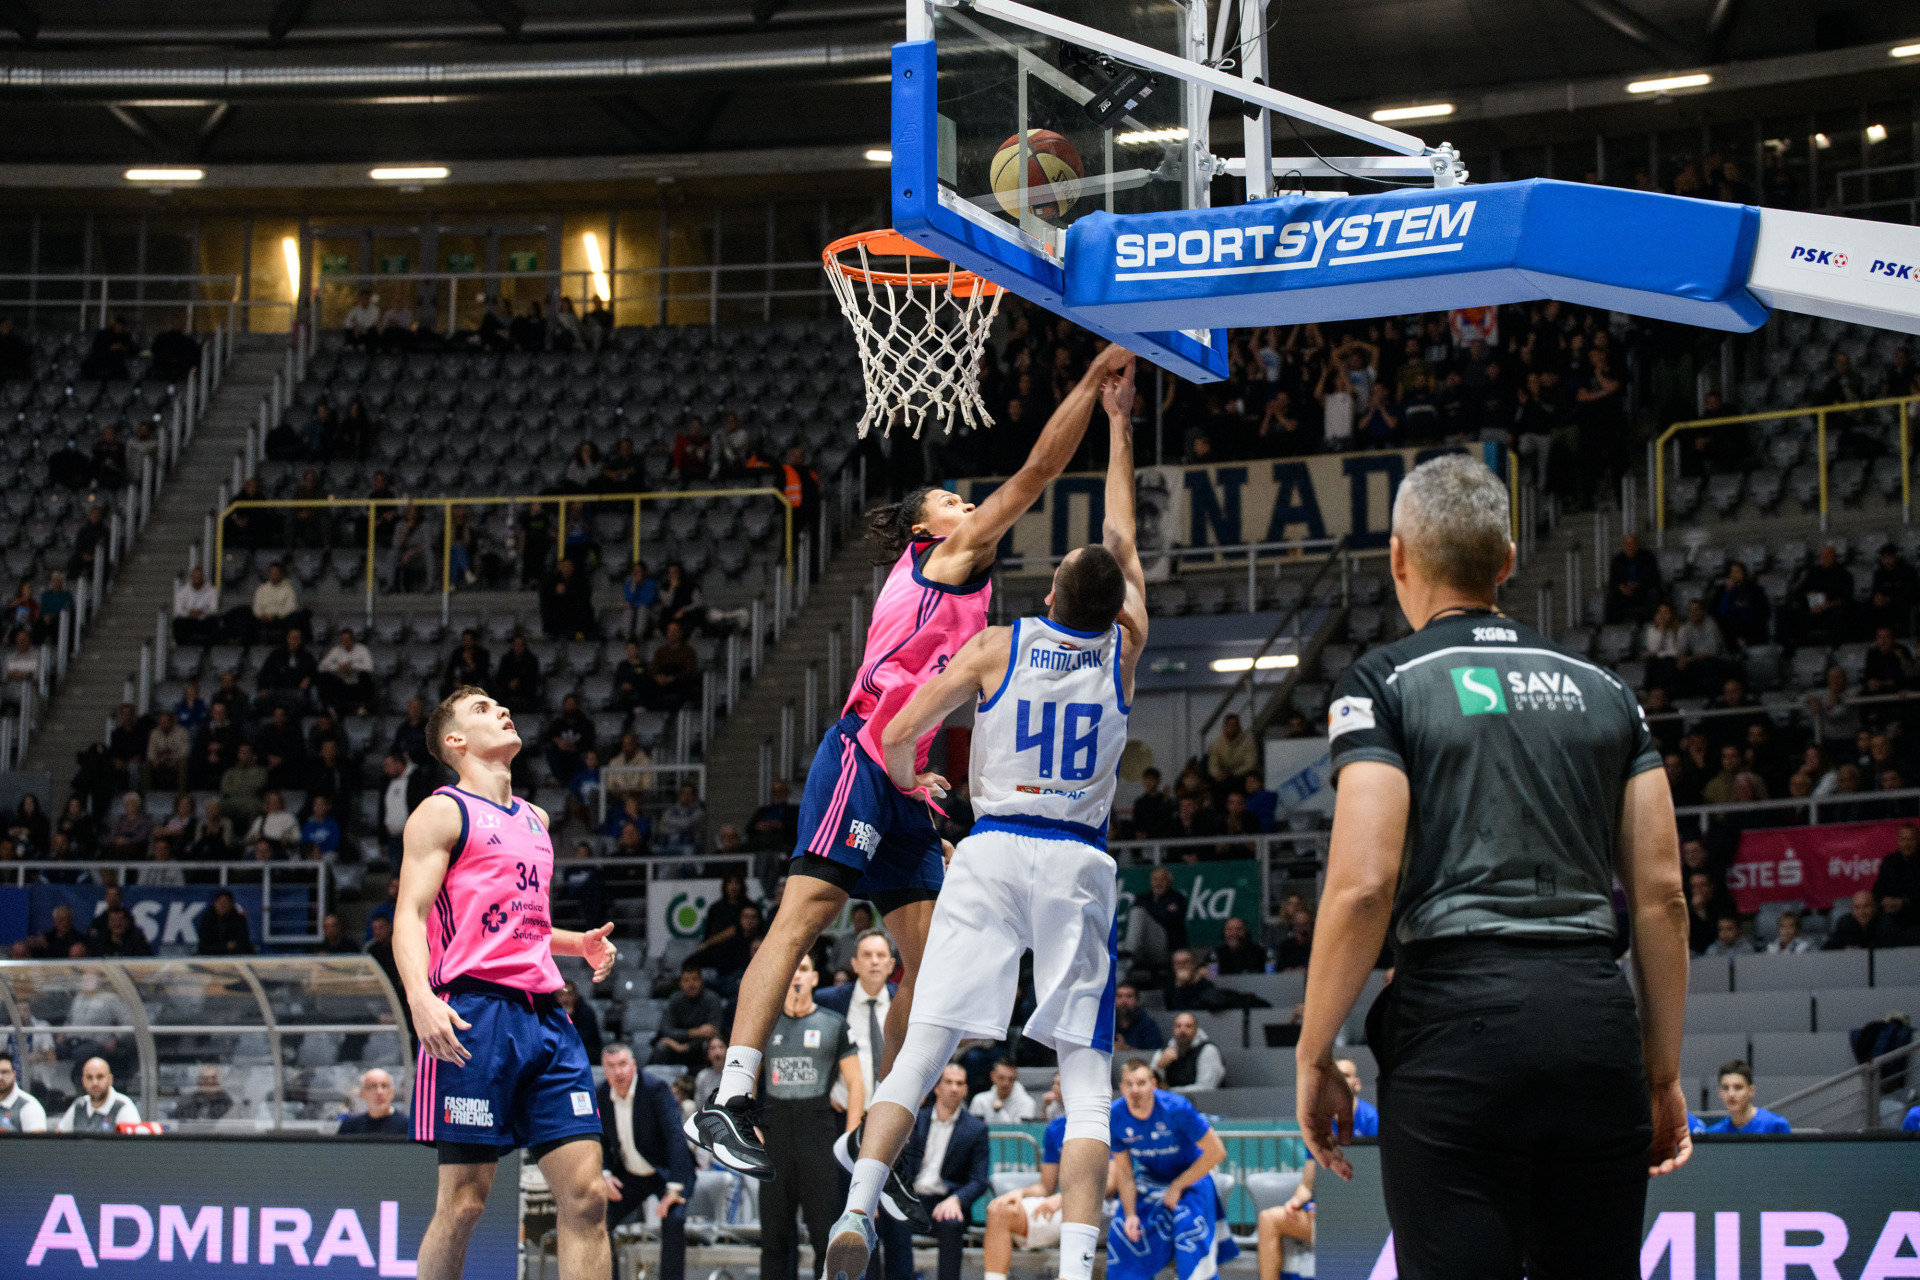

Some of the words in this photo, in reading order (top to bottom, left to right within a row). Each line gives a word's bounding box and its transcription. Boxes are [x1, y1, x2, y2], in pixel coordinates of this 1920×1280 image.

[1790, 246, 1833, 265] PSK
[1870, 260, 1913, 279] PSK
[1030, 648, 1103, 671] RAMLJAK
[1507, 671, 1583, 696] SAVA
[1015, 699, 1103, 781] 48
[515, 862, 540, 892] 34
[512, 928, 544, 941] Solutions
[444, 1096, 490, 1112] FASHION
[26, 1194, 418, 1278] ADMIRAL
